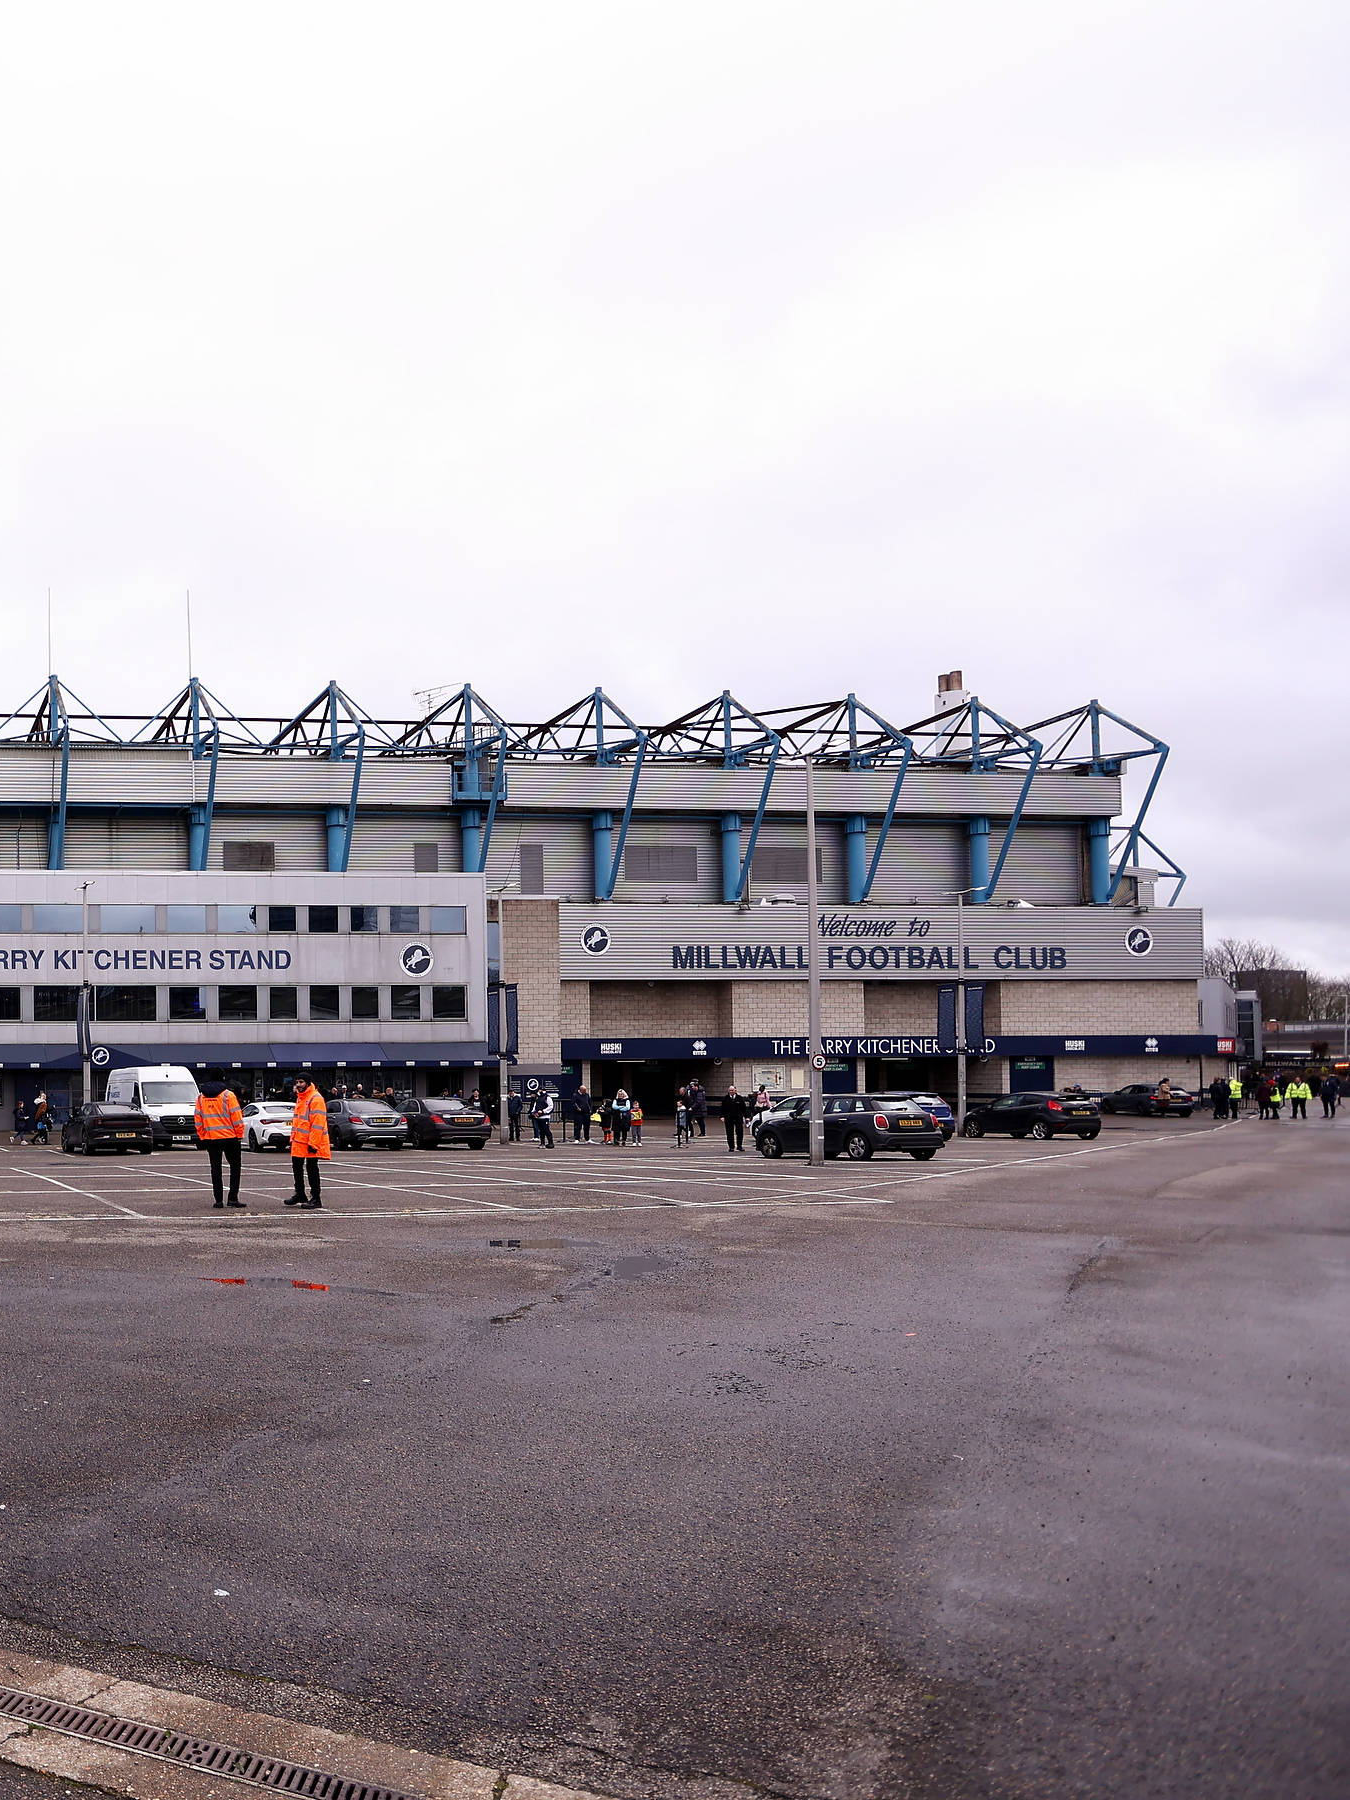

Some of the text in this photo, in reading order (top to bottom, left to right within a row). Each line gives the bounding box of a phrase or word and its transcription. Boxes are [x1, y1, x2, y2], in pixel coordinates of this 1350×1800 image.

[909, 916, 931, 937] to
[208, 949, 292, 970] STAND
[672, 945, 1067, 970] MILLWALL FOOTBALL CLUB
[772, 1040, 800, 1054] THE
[857, 1039, 940, 1054] KITCHENER
[816, 1058, 822, 1066] 5
